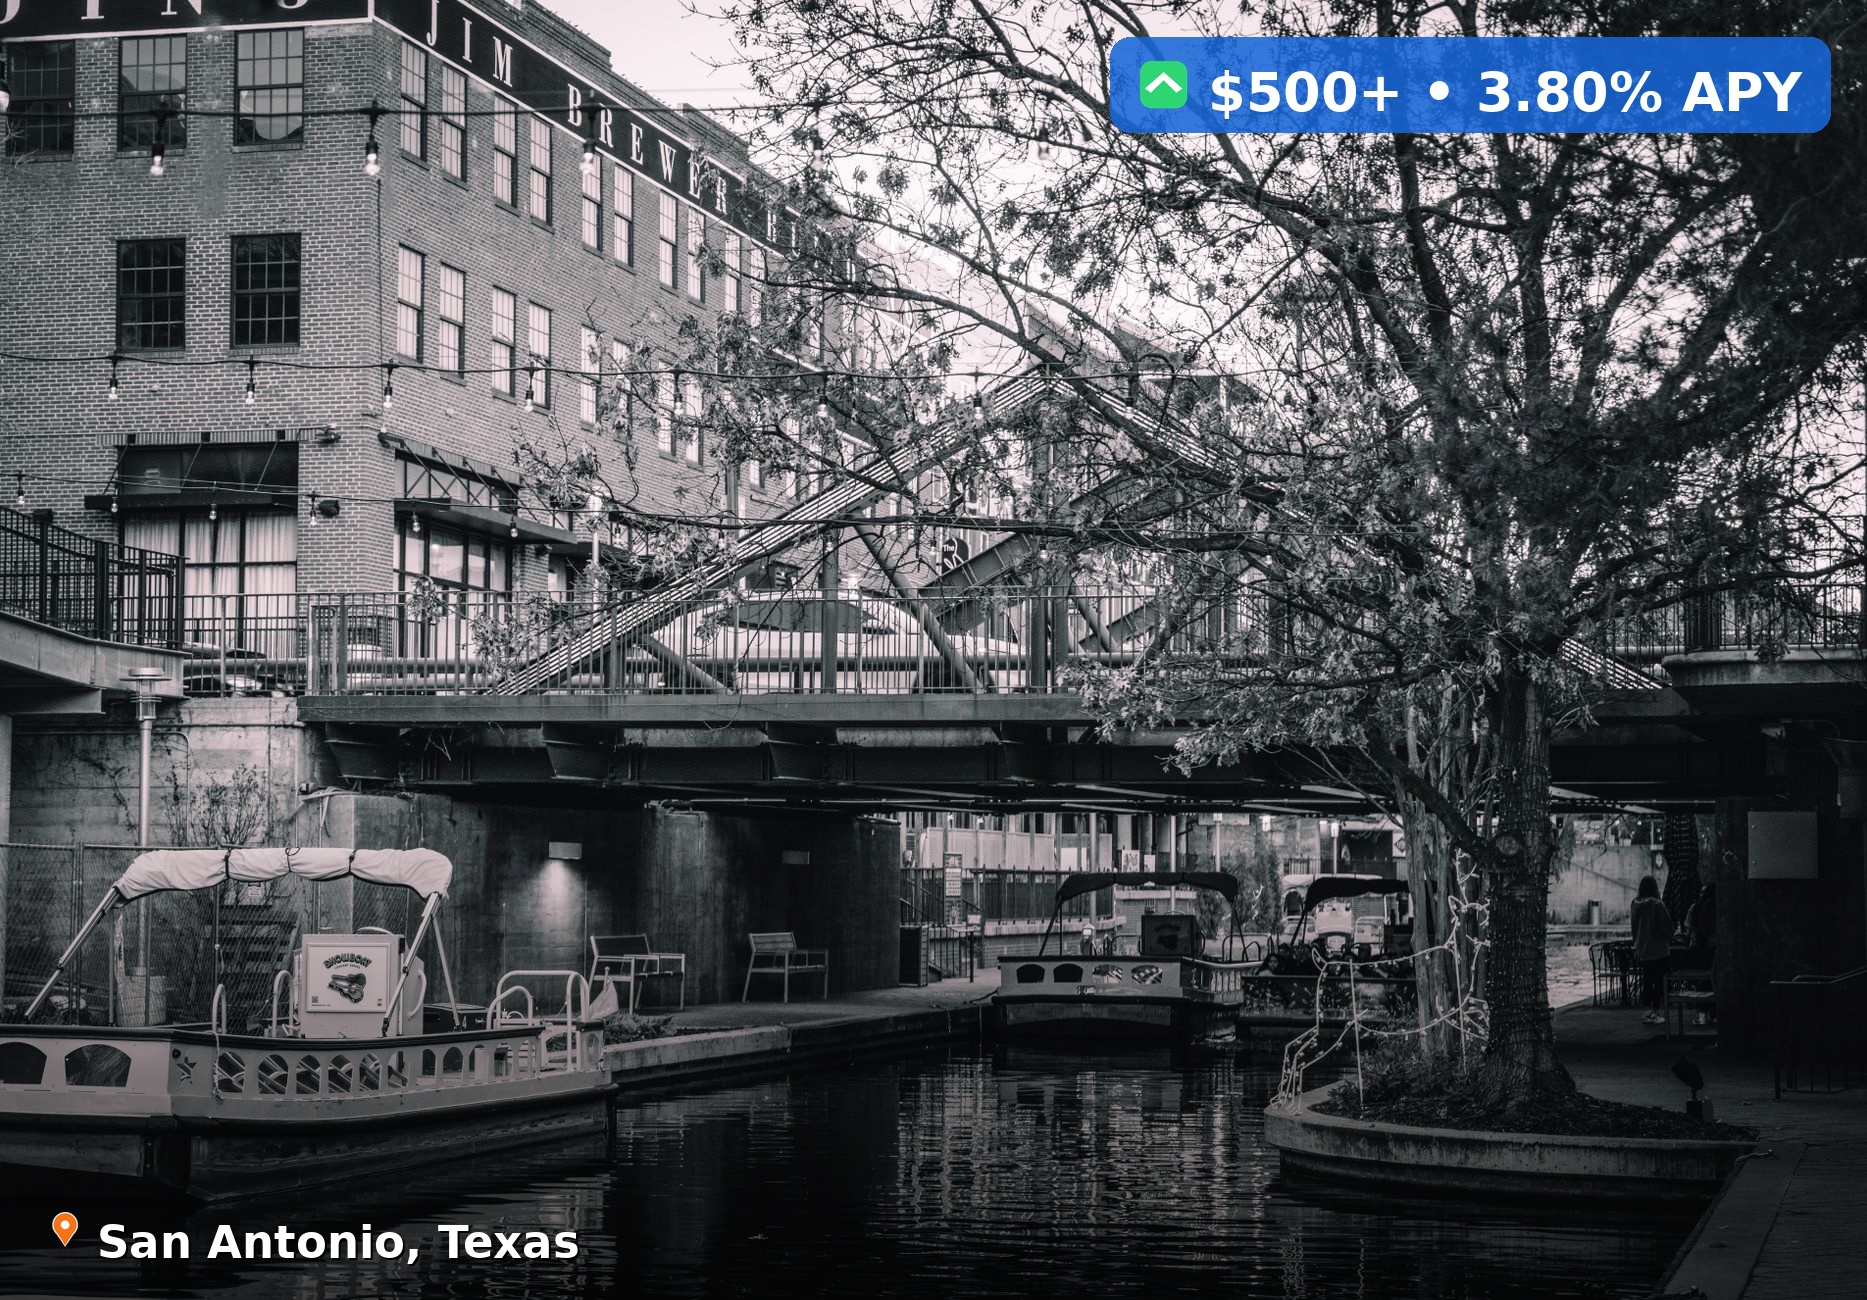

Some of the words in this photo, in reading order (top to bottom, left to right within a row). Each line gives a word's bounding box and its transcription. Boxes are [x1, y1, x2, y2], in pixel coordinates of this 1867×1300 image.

[426, 0, 513, 87] JIM
[567, 83, 727, 215] BREWER
[943, 544, 955, 552] The
